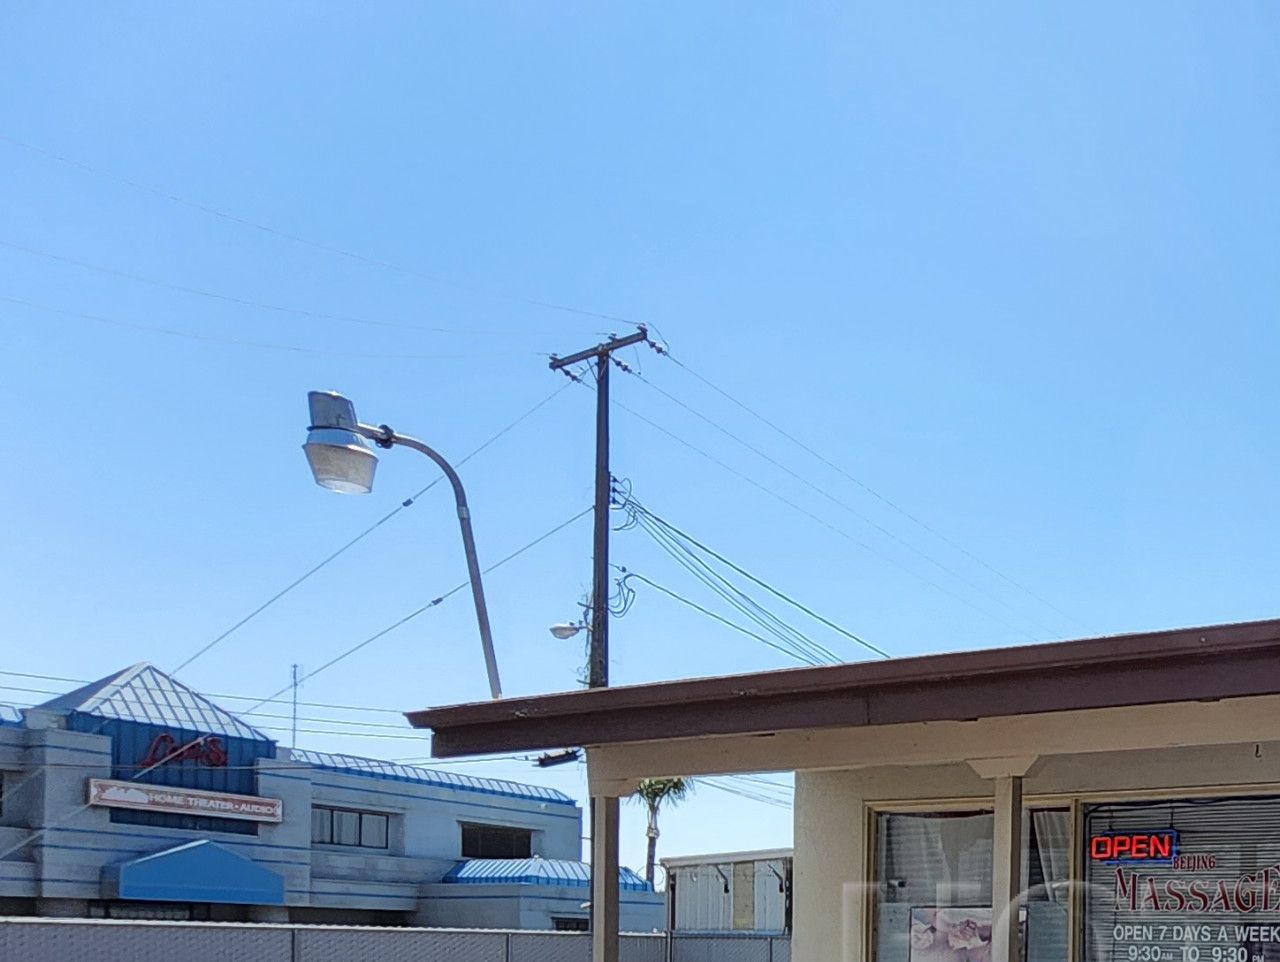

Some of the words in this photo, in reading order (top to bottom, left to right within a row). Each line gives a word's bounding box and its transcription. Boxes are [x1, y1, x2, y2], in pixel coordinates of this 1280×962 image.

[149, 792, 185, 805] HOME
[187, 797, 234, 810] THEATER
[1090, 834, 1172, 860] OPEN
[1172, 853, 1217, 873] BEIJING
[1112, 925, 1153, 942] OPEN
[1158, 925, 1168, 941] 7
[1172, 925, 1212, 942] DAYS
[1217, 926, 1228, 942] A
[1179, 946, 1200, 962] TO
